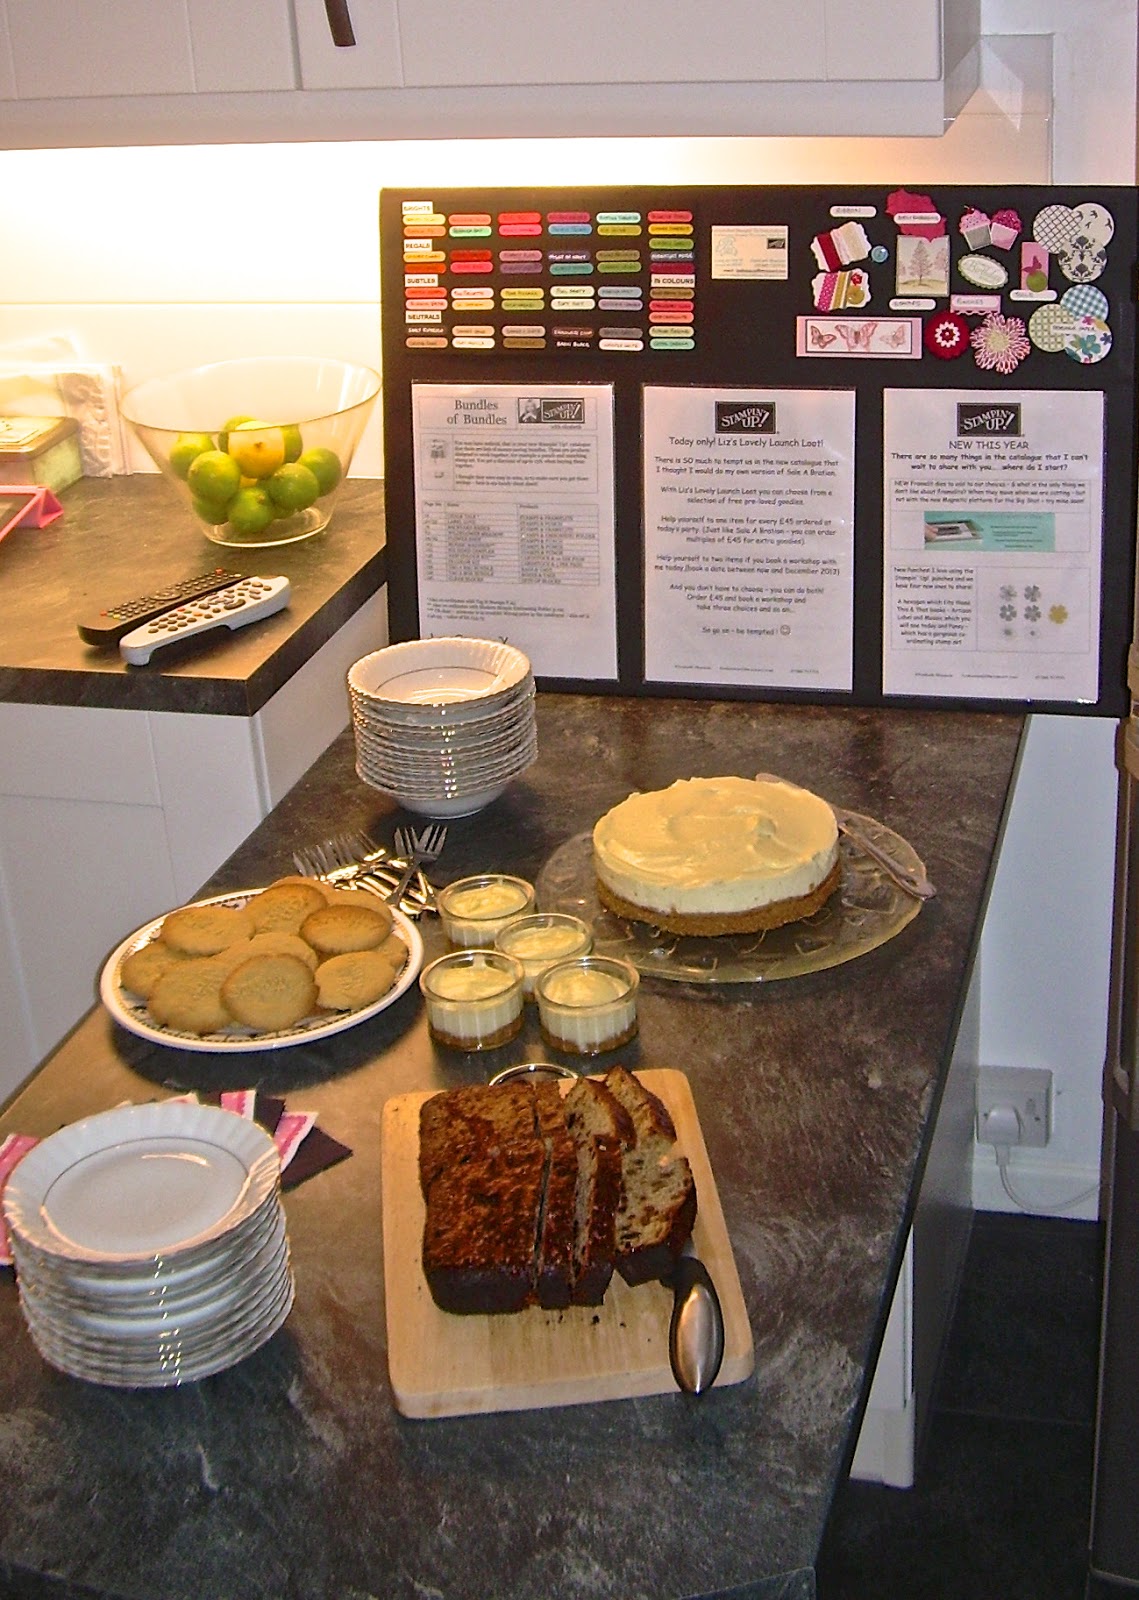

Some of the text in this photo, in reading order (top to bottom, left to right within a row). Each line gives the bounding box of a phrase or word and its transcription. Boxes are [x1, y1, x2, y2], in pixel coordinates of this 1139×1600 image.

[455, 399, 498, 410] Bundles
[446, 413, 507, 425] of Bundles
[670, 437, 694, 447] Today
[696, 437, 716, 448] only!
[718, 437, 737, 445] Liz's
[739, 437, 767, 448] Lovely
[769, 438, 799, 446] Launch
[949, 441, 1029, 449] NEW THIS YEAR
[655, 456, 674, 464] There
[723, 457, 743, 467] tempt
[790, 458, 822, 468] catalogue
[892, 452, 912, 460] There
[940, 454, 958, 462] many
[961, 453, 982, 462] things
[1009, 453, 1042, 463] catalogue
[662, 466, 687, 475] thought
[695, 466, 713, 474] would
[725, 468, 734, 476] my
[751, 467, 775, 475] version
[1002, 463, 1024, 471] where
[1026, 463, 1035, 471] do
[1045, 463, 1067, 471] start?
[678, 485, 693, 493] Liz's
[694, 486, 715, 495] Lovely
[716, 486, 740, 494] Launch
[758, 489, 770, 497] you
